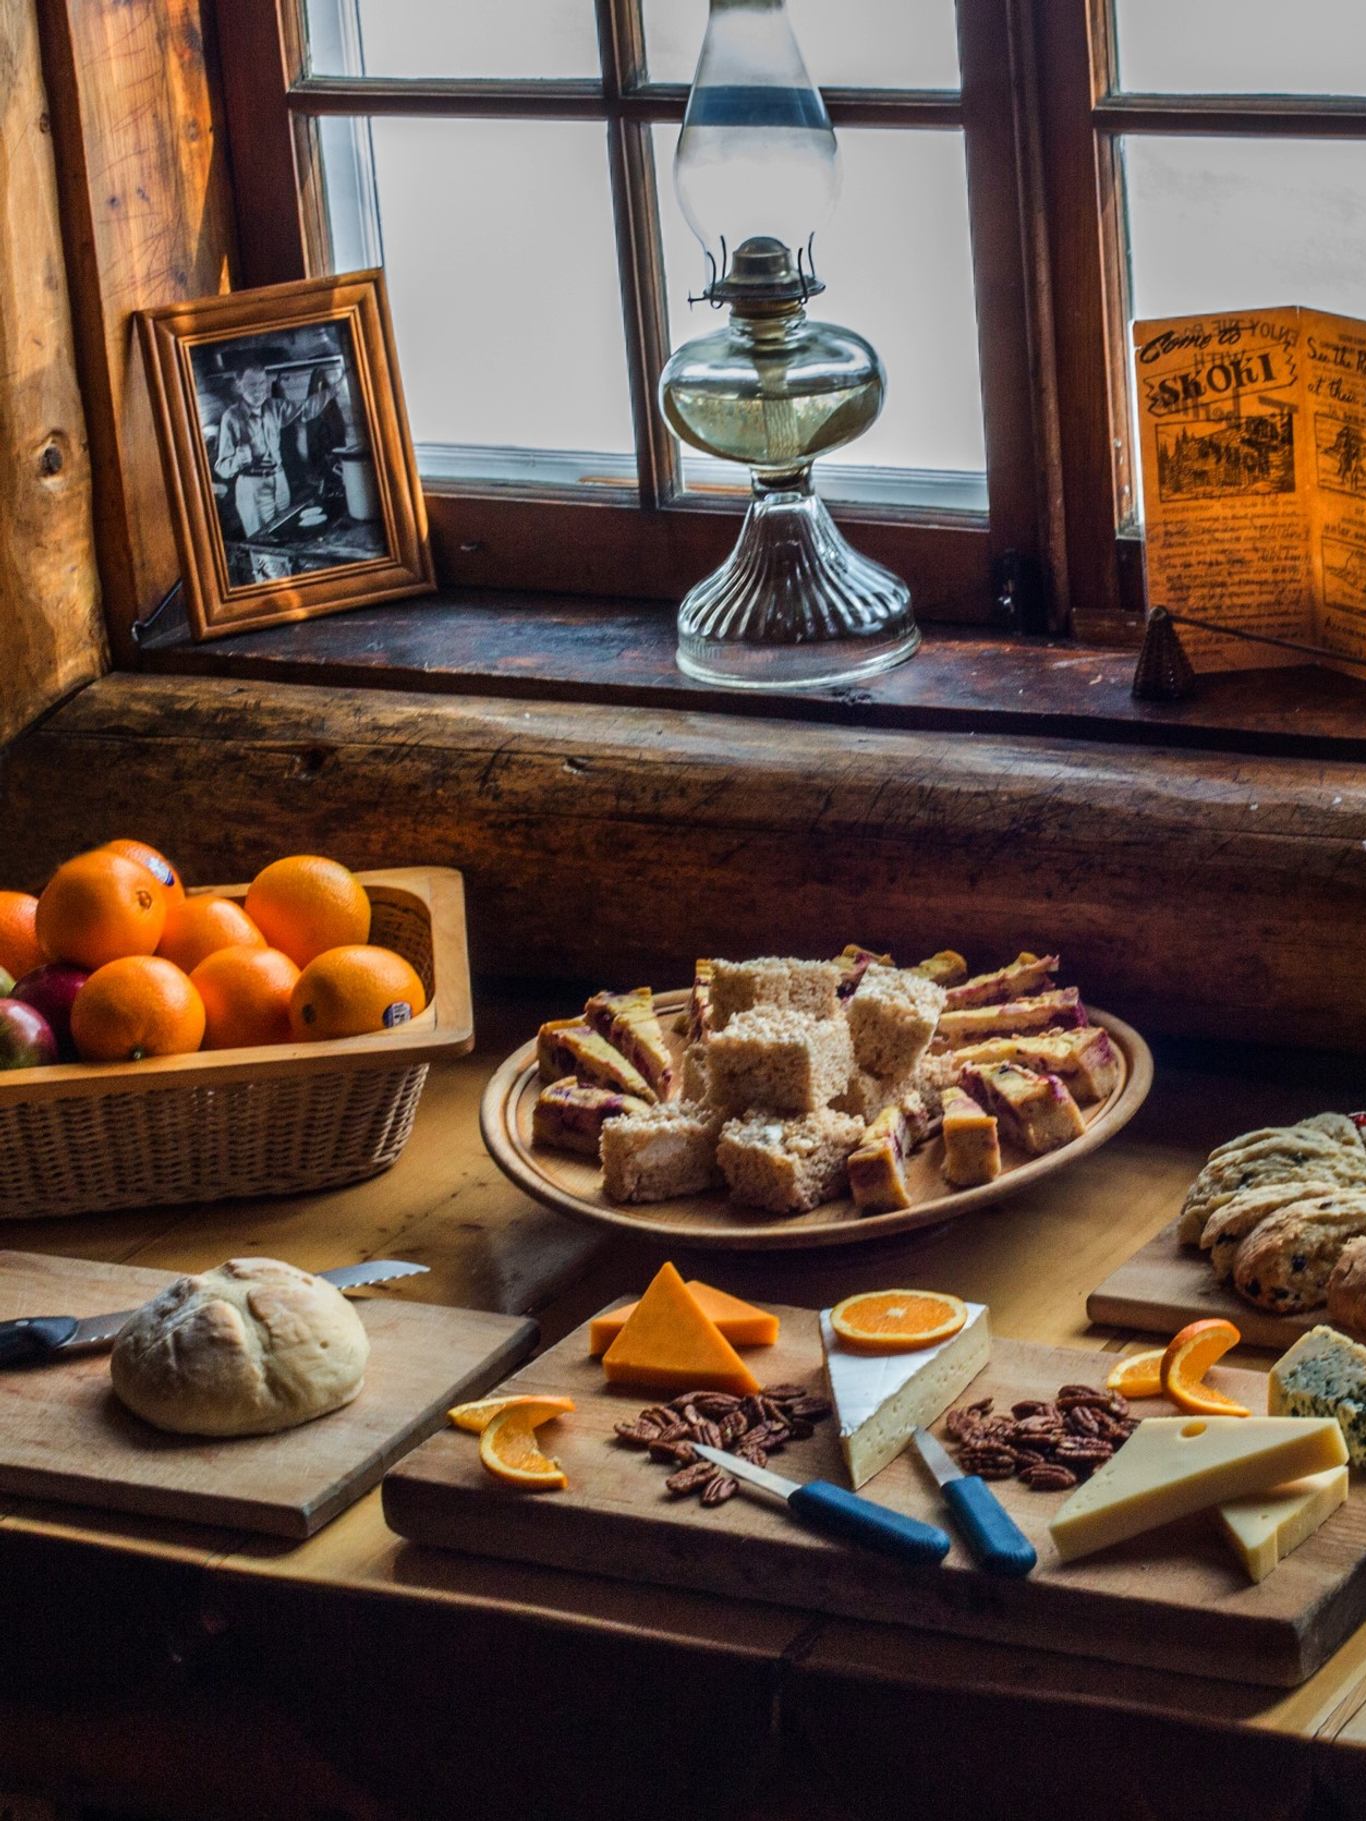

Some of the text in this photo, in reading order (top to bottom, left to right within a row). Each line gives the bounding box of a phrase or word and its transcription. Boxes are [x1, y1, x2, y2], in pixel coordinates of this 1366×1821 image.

[1140, 330, 1213, 364] Come
[1218, 320, 1252, 345] to
[1158, 353, 1276, 408] SKOKI
